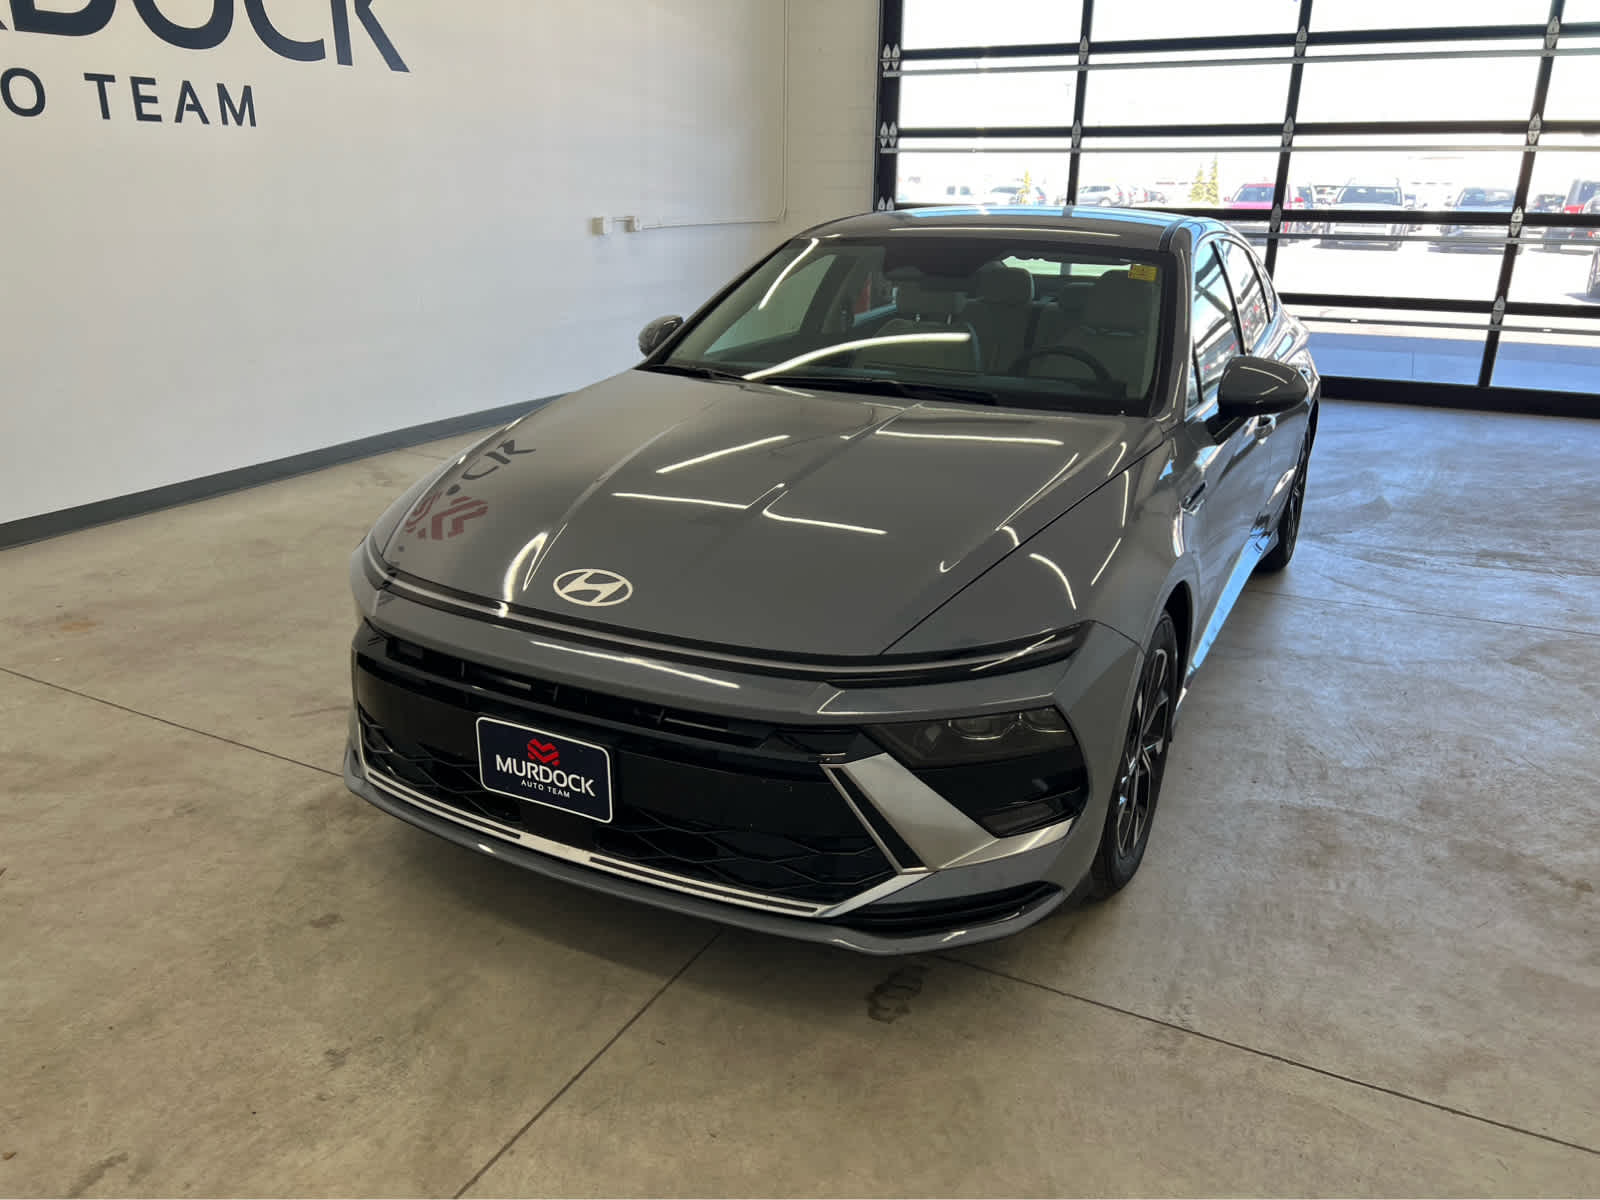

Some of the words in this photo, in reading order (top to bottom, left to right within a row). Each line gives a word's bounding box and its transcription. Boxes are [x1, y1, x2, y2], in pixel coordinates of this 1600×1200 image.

[83, 73, 257, 127] TEAM
[495, 754, 596, 797] MURDOCK
[521, 779, 544, 791] AUTO
[548, 786, 571, 798] TEAM
